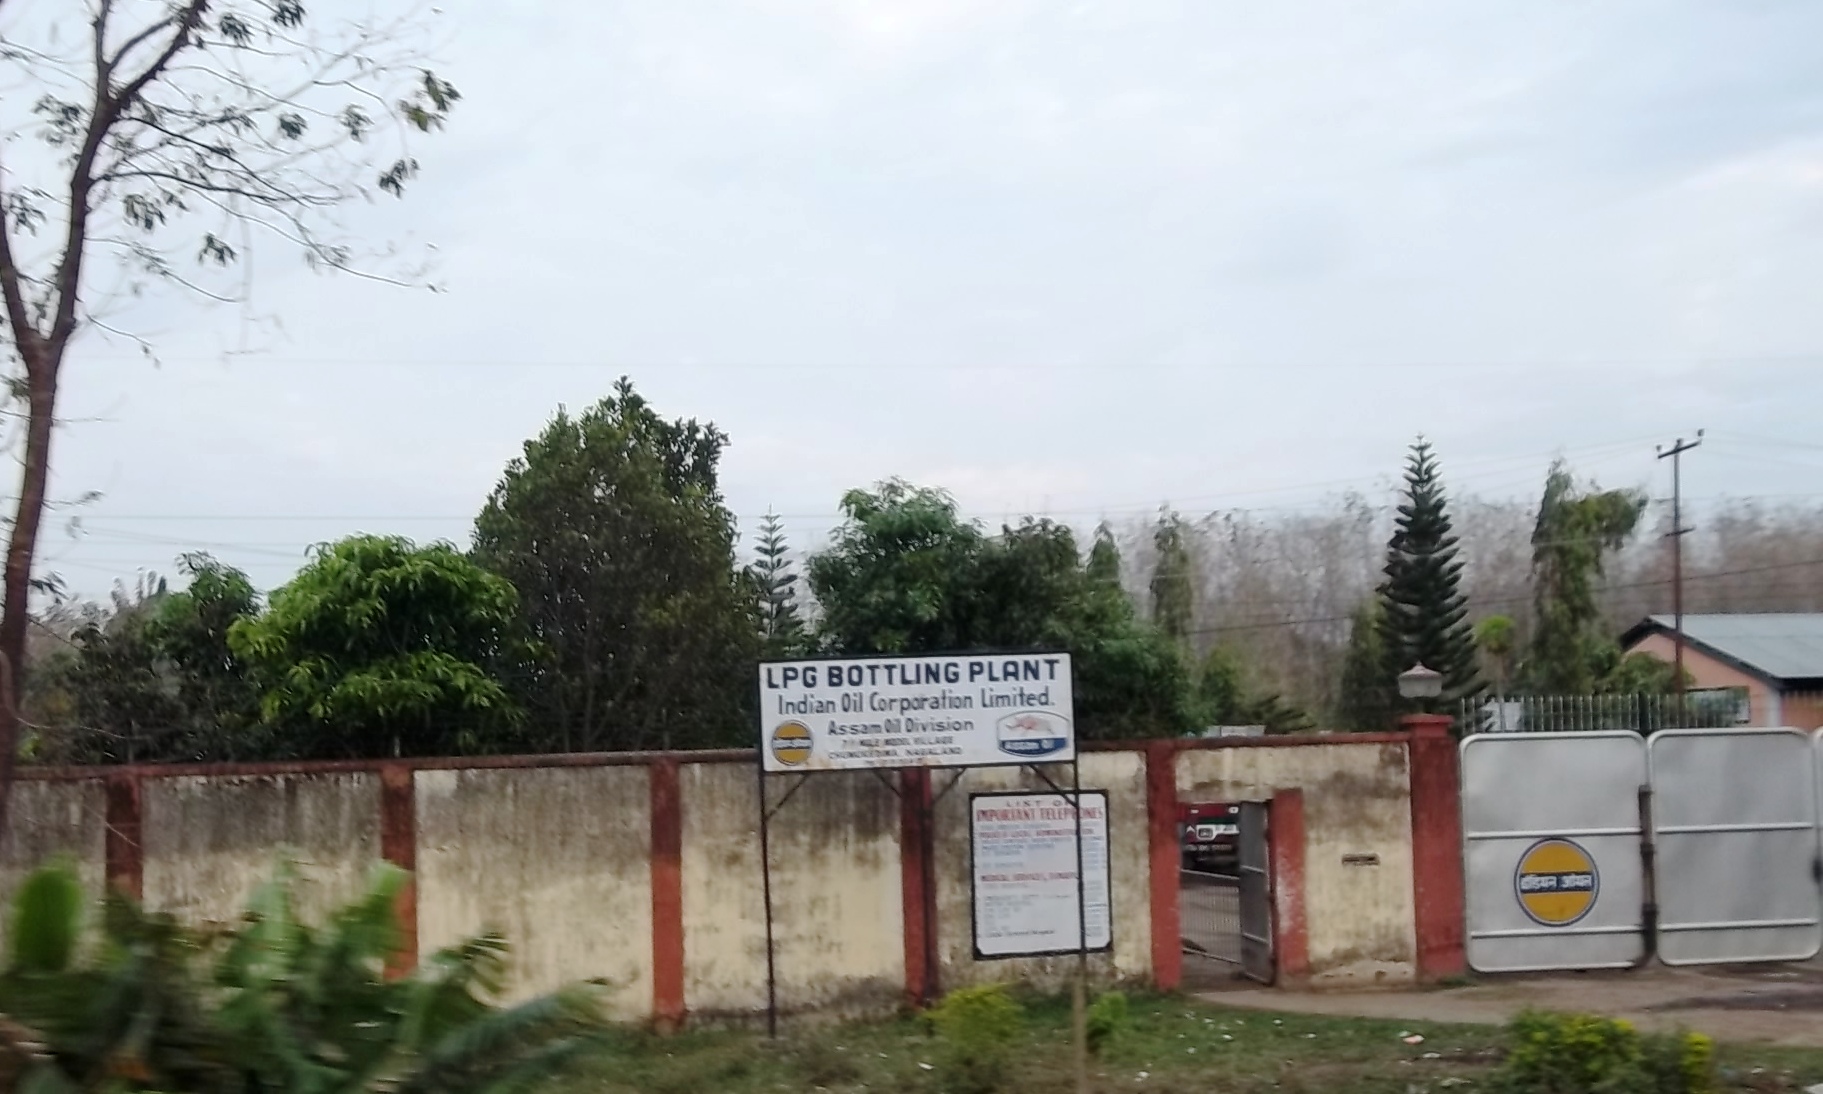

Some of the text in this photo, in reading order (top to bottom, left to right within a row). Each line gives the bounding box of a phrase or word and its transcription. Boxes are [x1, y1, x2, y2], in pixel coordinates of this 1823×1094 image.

[767, 658, 1060, 689] LPG BOTTLING PLANT
[778, 693, 836, 715] Indian
[841, 692, 864, 713] Oil
[870, 689, 973, 715] Corporation
[828, 716, 975, 735] Assam Oil Division
